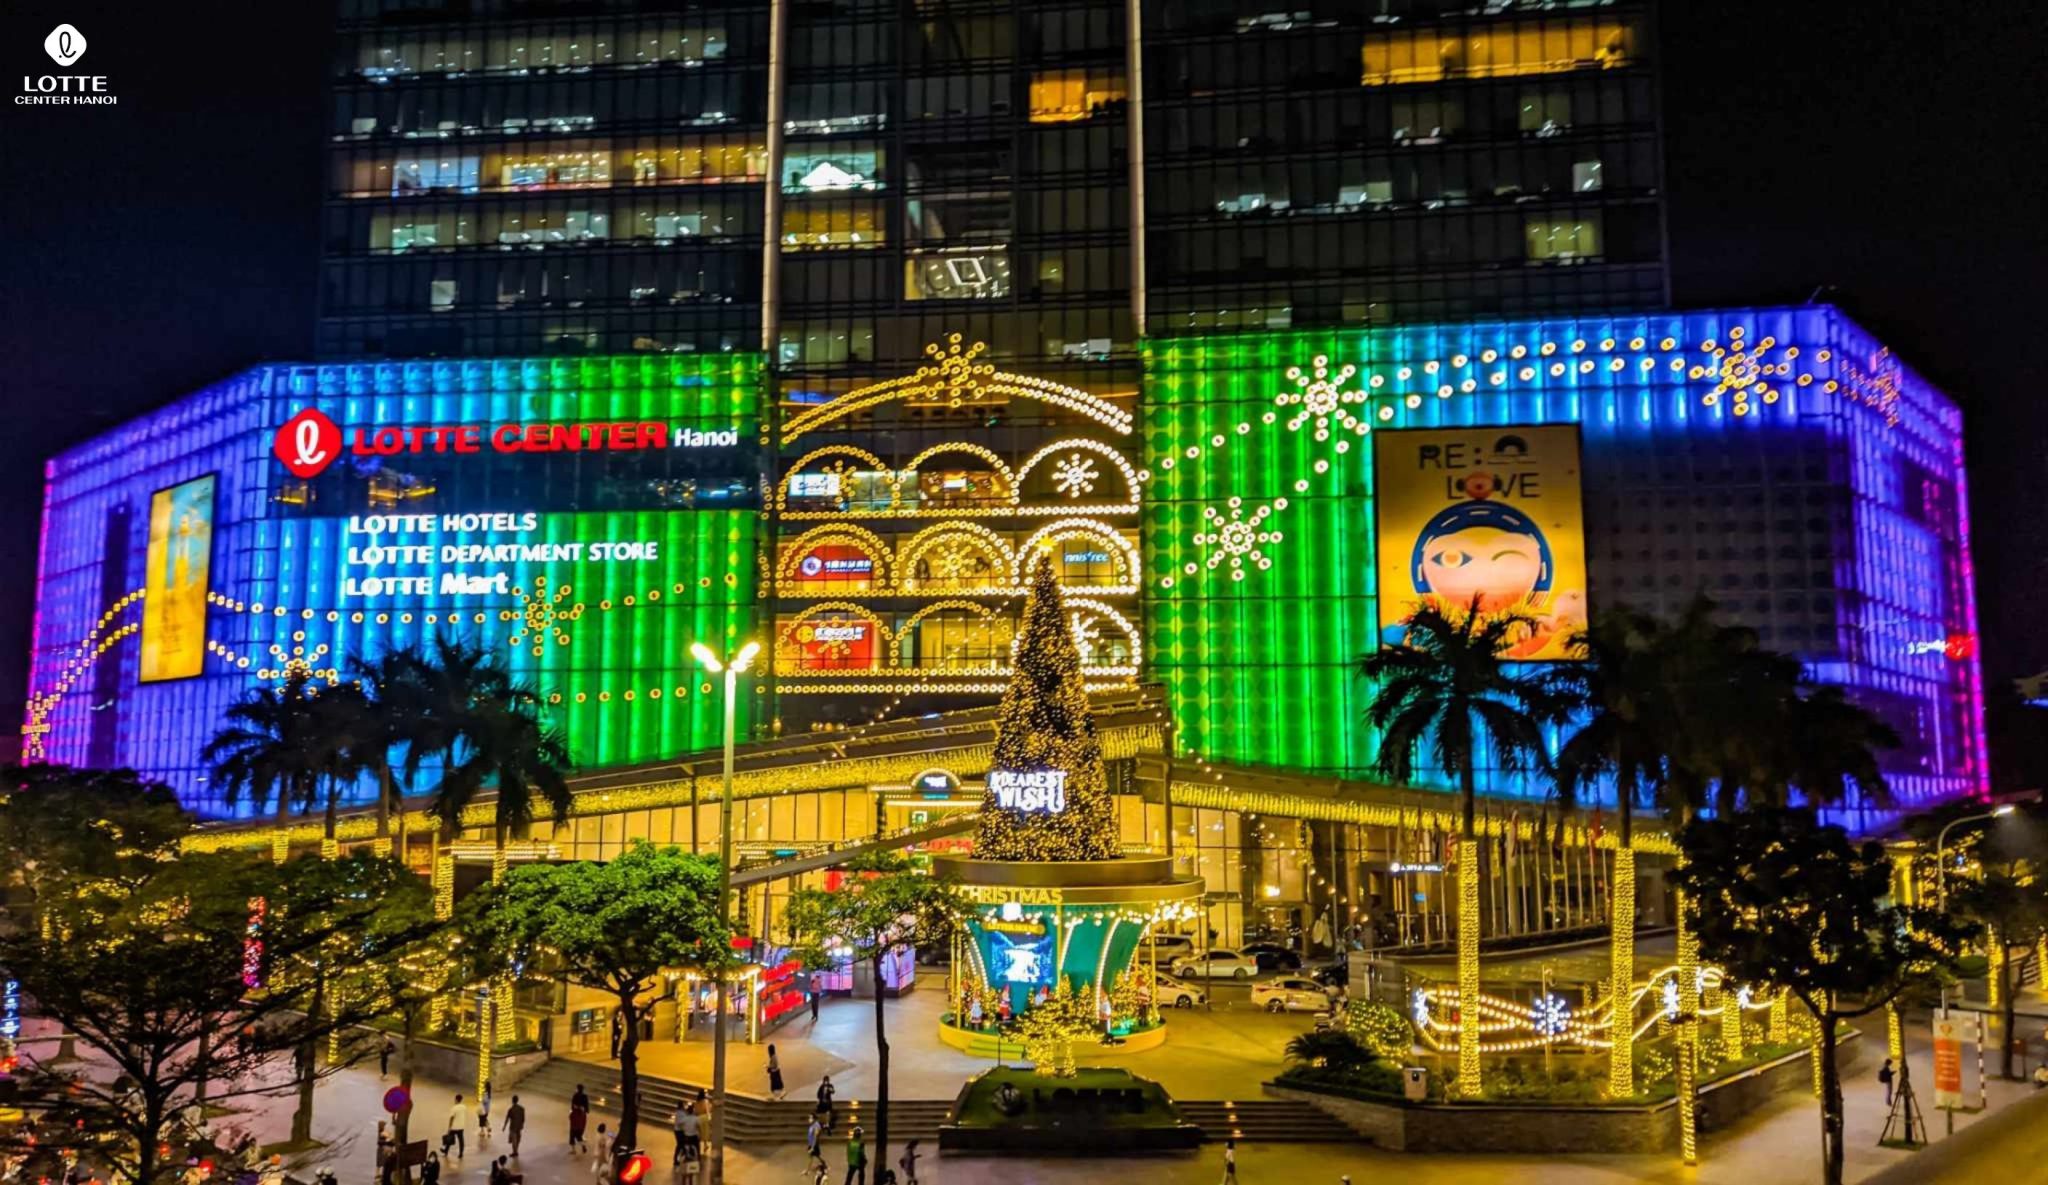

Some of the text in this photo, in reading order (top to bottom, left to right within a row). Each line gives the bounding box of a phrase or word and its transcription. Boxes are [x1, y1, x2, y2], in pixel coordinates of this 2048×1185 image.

[352, 422, 738, 455] LOTTE CENTER Hanoi
[350, 513, 537, 534] LOTTE HOTELS
[348, 542, 658, 565] LOTTE DEPARTMENT STORE
[346, 572, 509, 596] LOTTE Mart
